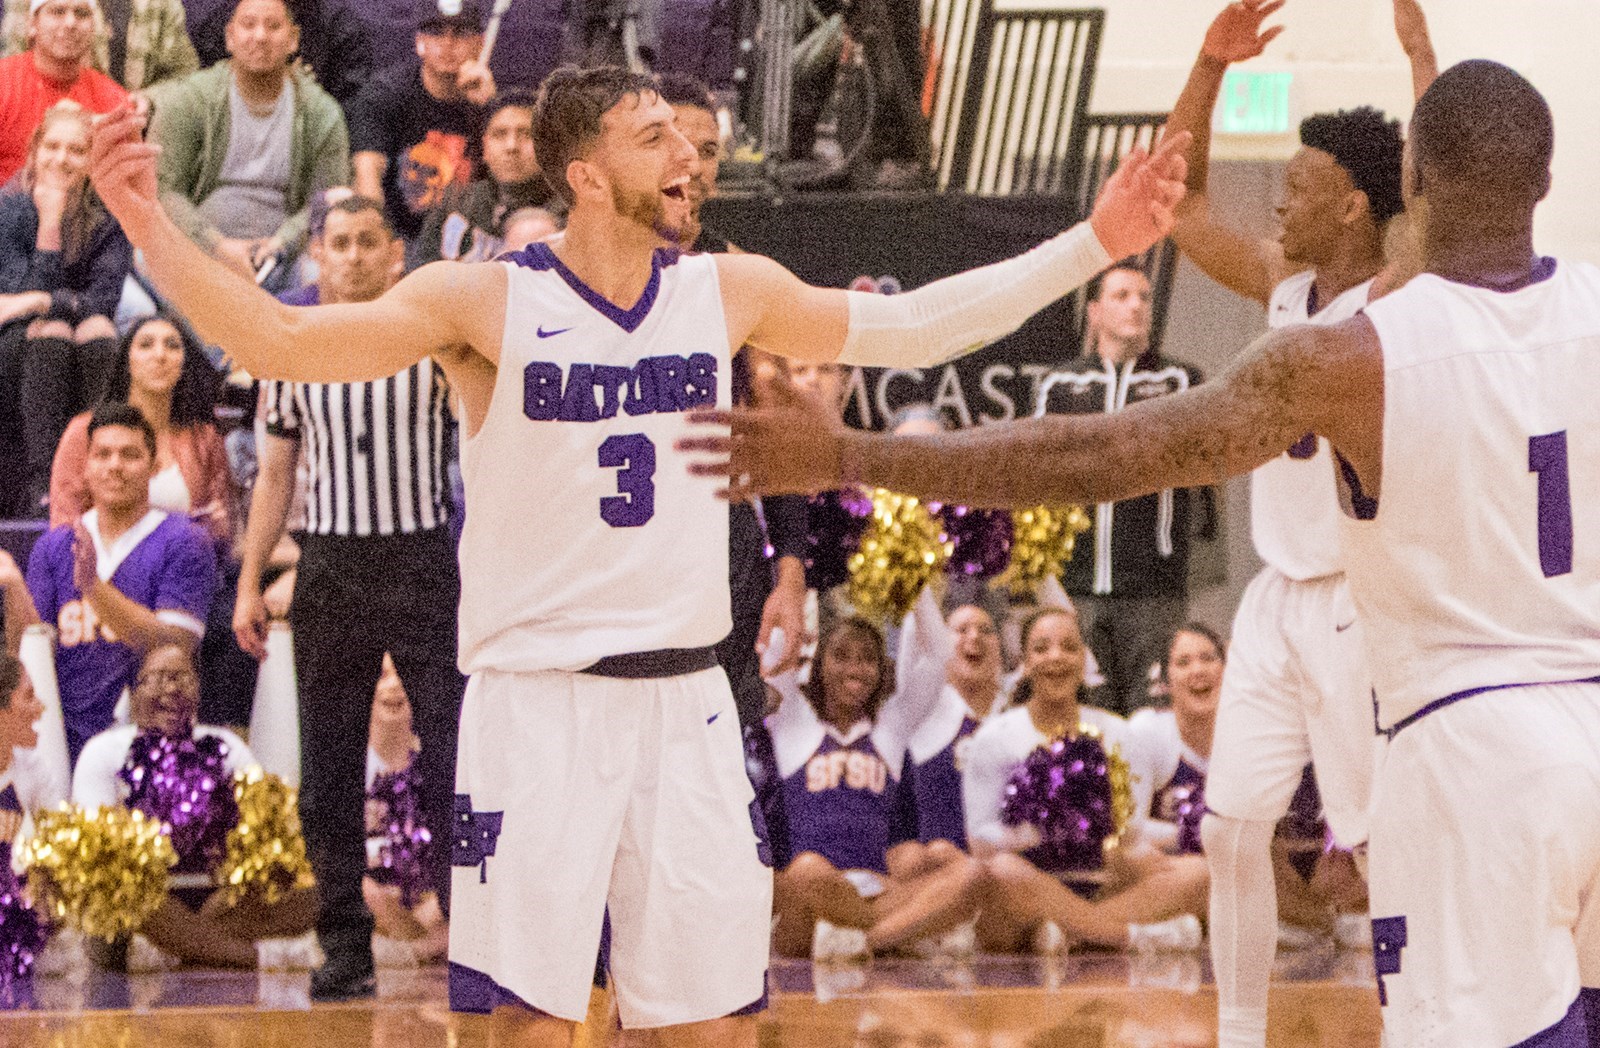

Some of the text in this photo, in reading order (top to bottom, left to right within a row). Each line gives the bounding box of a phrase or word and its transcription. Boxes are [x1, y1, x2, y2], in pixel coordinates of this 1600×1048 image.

[1224, 72, 1294, 133] EXIT
[523, 352, 719, 422] GATORS
[598, 432, 656, 528] 3
[1528, 429, 1574, 579] 1
[58, 598, 117, 647] SF
[805, 750, 888, 794] SFSU
